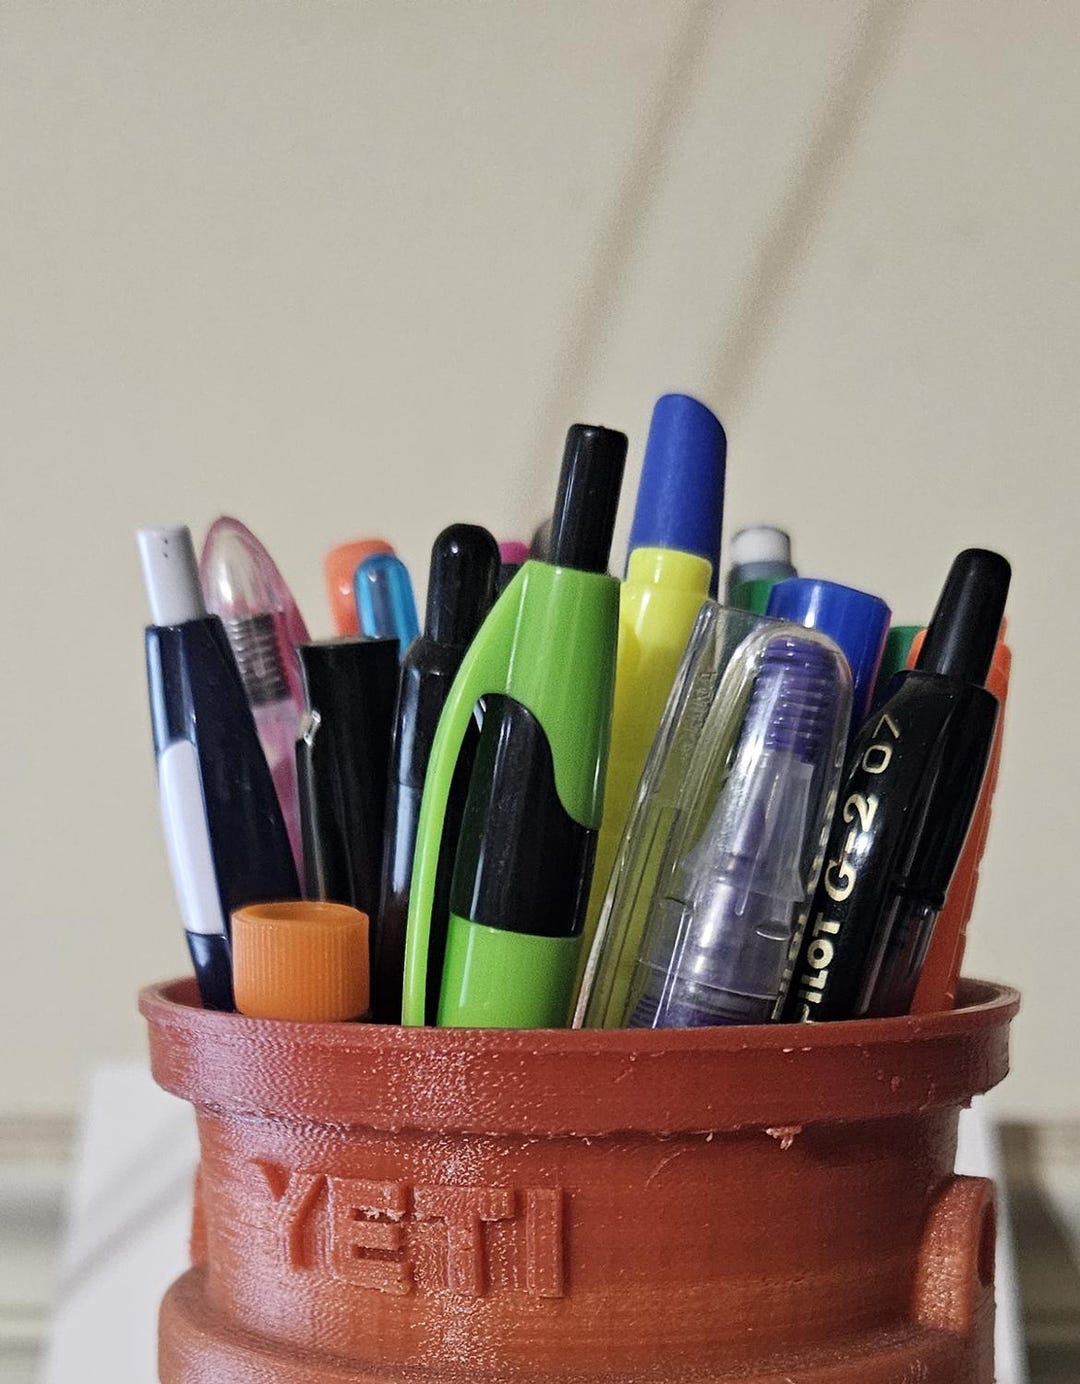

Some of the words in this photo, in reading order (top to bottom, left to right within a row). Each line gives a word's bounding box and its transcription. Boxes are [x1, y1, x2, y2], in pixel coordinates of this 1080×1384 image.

[825, 793, 878, 902] G-2
[861, 713, 900, 775] 07
[241, 1156, 565, 1299] YETI
